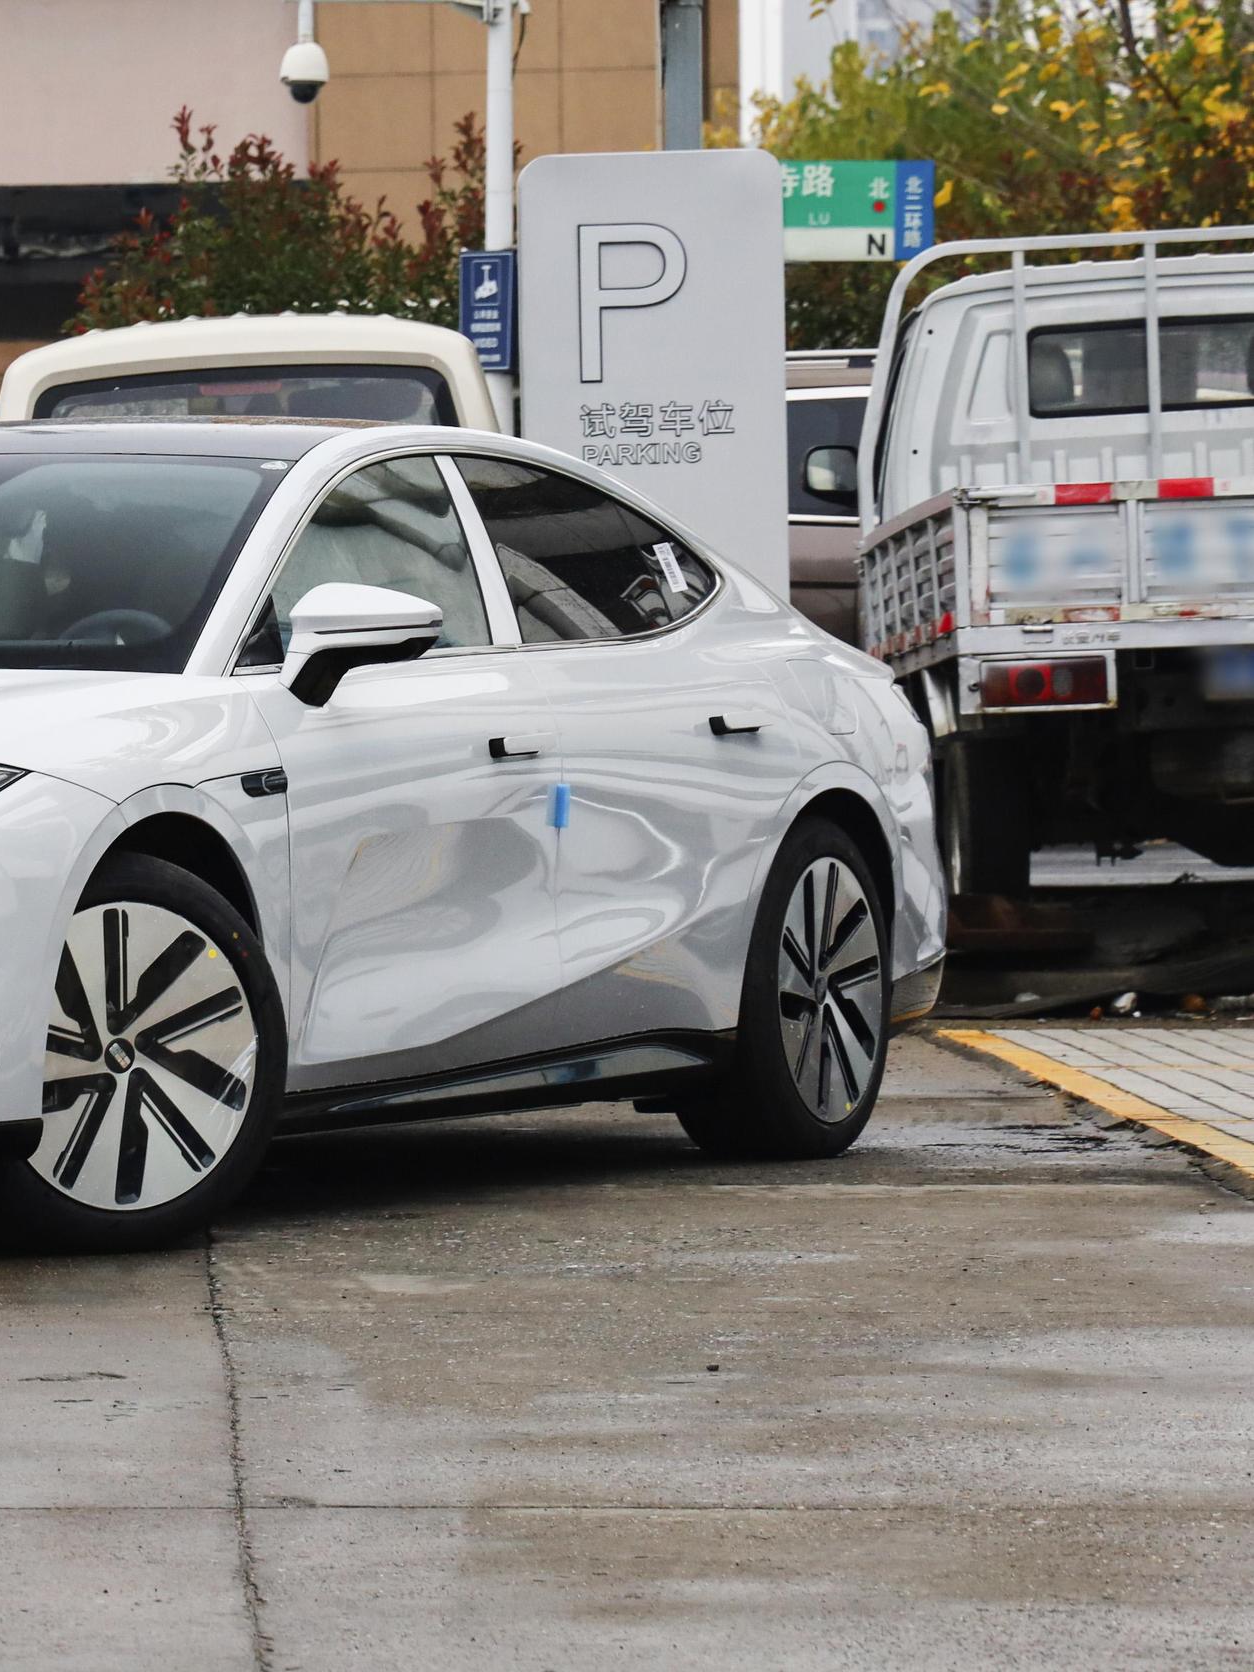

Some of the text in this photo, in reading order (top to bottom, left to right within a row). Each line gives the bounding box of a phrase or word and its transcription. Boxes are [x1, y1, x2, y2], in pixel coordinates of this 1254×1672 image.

[868, 177, 890, 199] 北
[808, 212, 831, 225] LU
[903, 176, 923, 248] 北二环路
[867, 234, 886, 256] N
[577, 222, 687, 383] P
[579, 399, 735, 438] 试驾车位
[582, 441, 702, 466] PARKING
